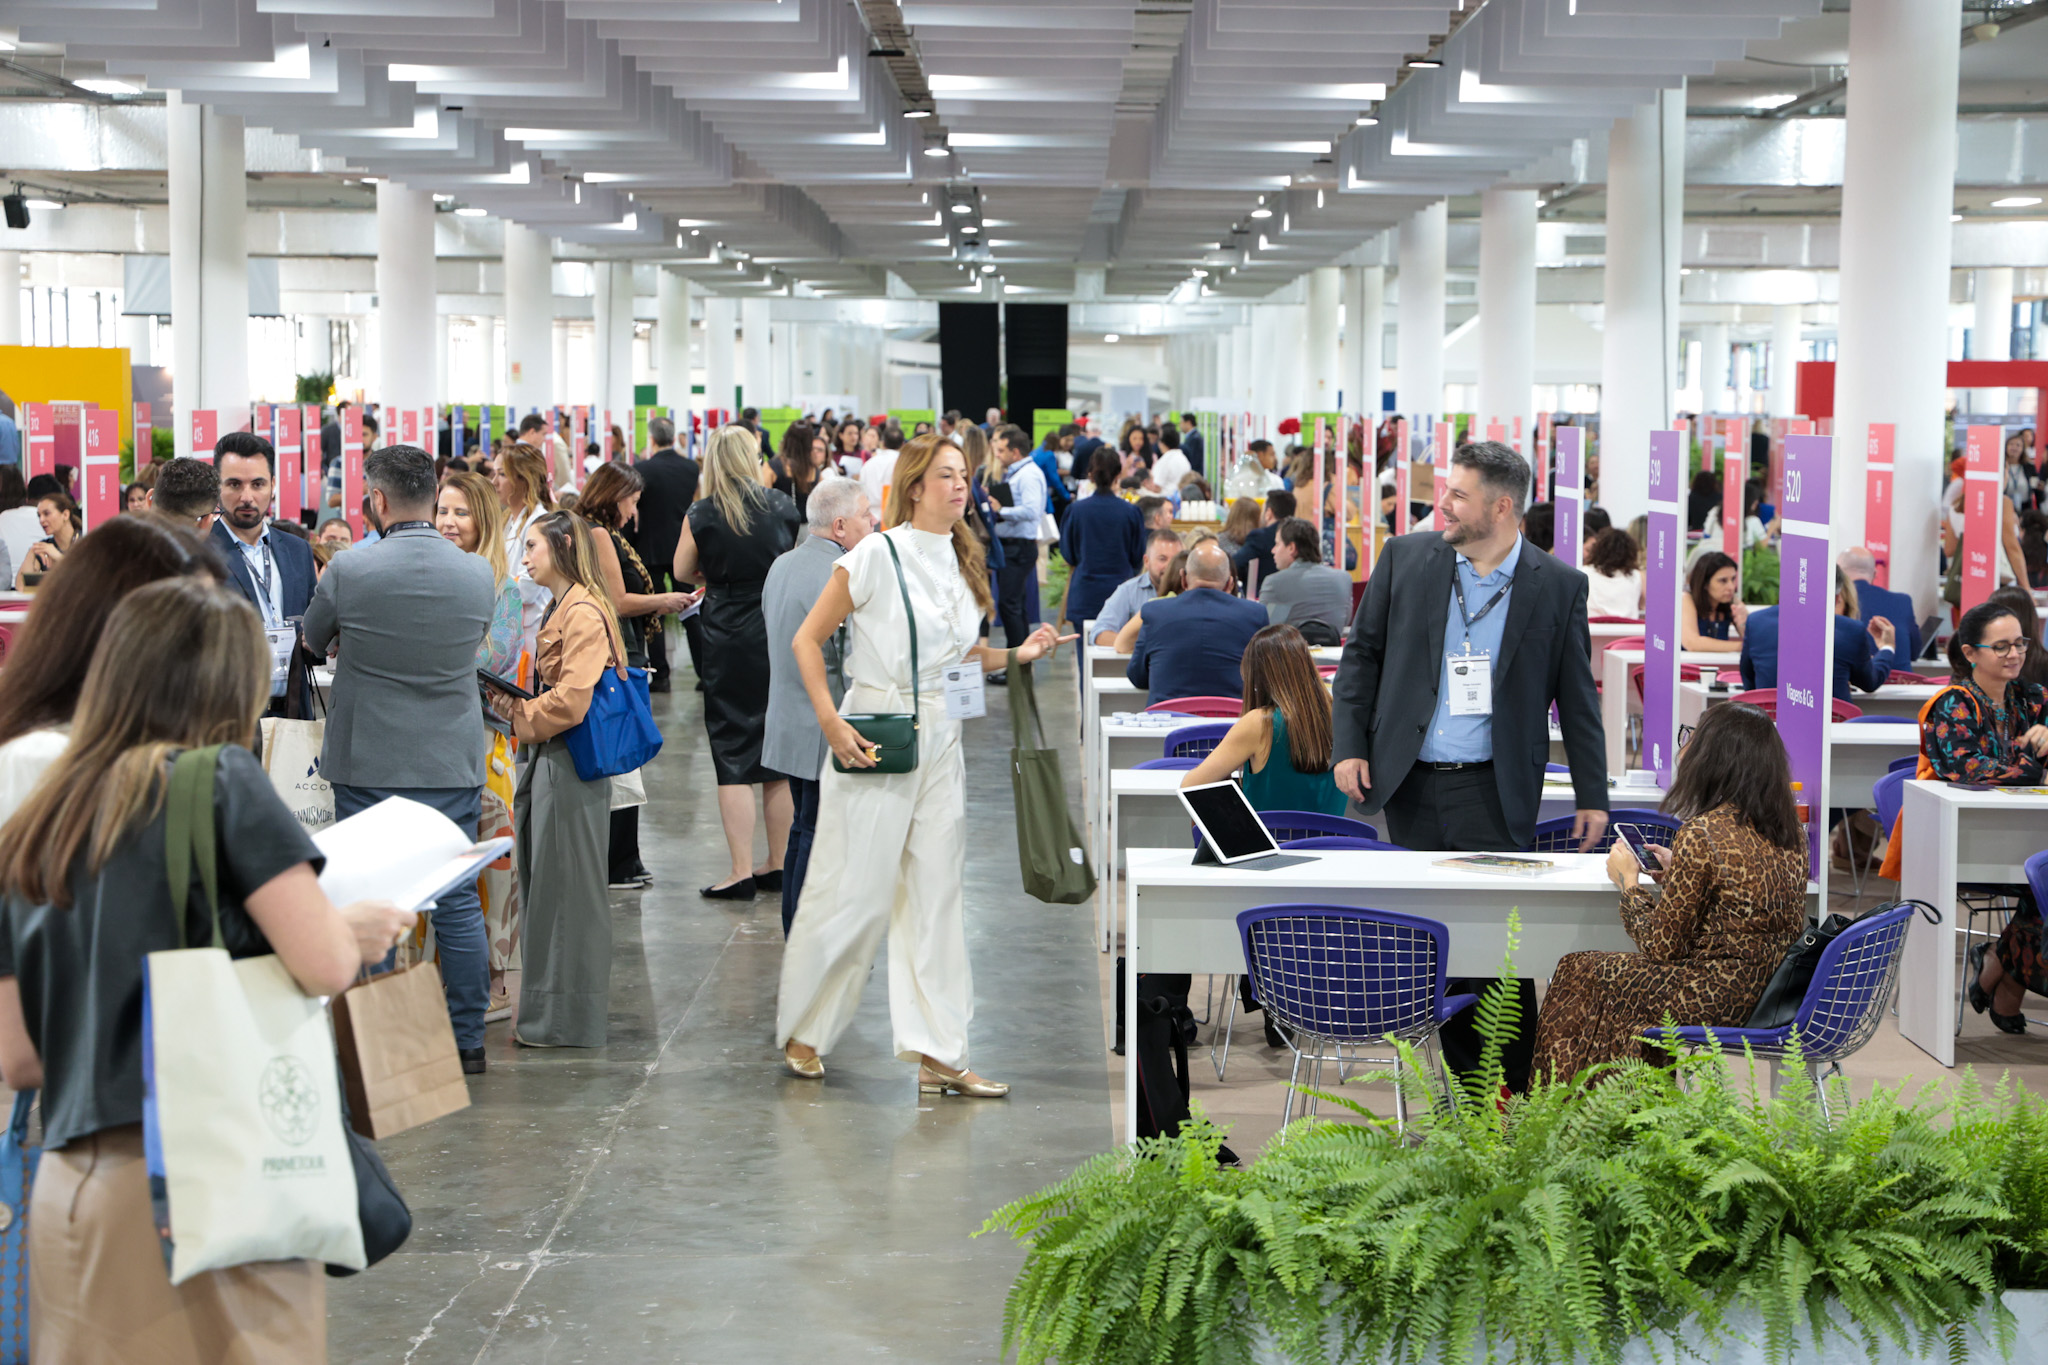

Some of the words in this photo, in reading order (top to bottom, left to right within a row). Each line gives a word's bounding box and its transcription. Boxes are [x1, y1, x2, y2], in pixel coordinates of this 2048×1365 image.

[30, 417, 39, 431] 312
[194, 426, 203, 443] 415
[87, 428, 100, 447] 416
[1650, 459, 1661, 486] 519
[1785, 470, 1801, 503] 520
[1786, 682, 1803, 706] Viagens
[1806, 689, 1814, 708] Cia
